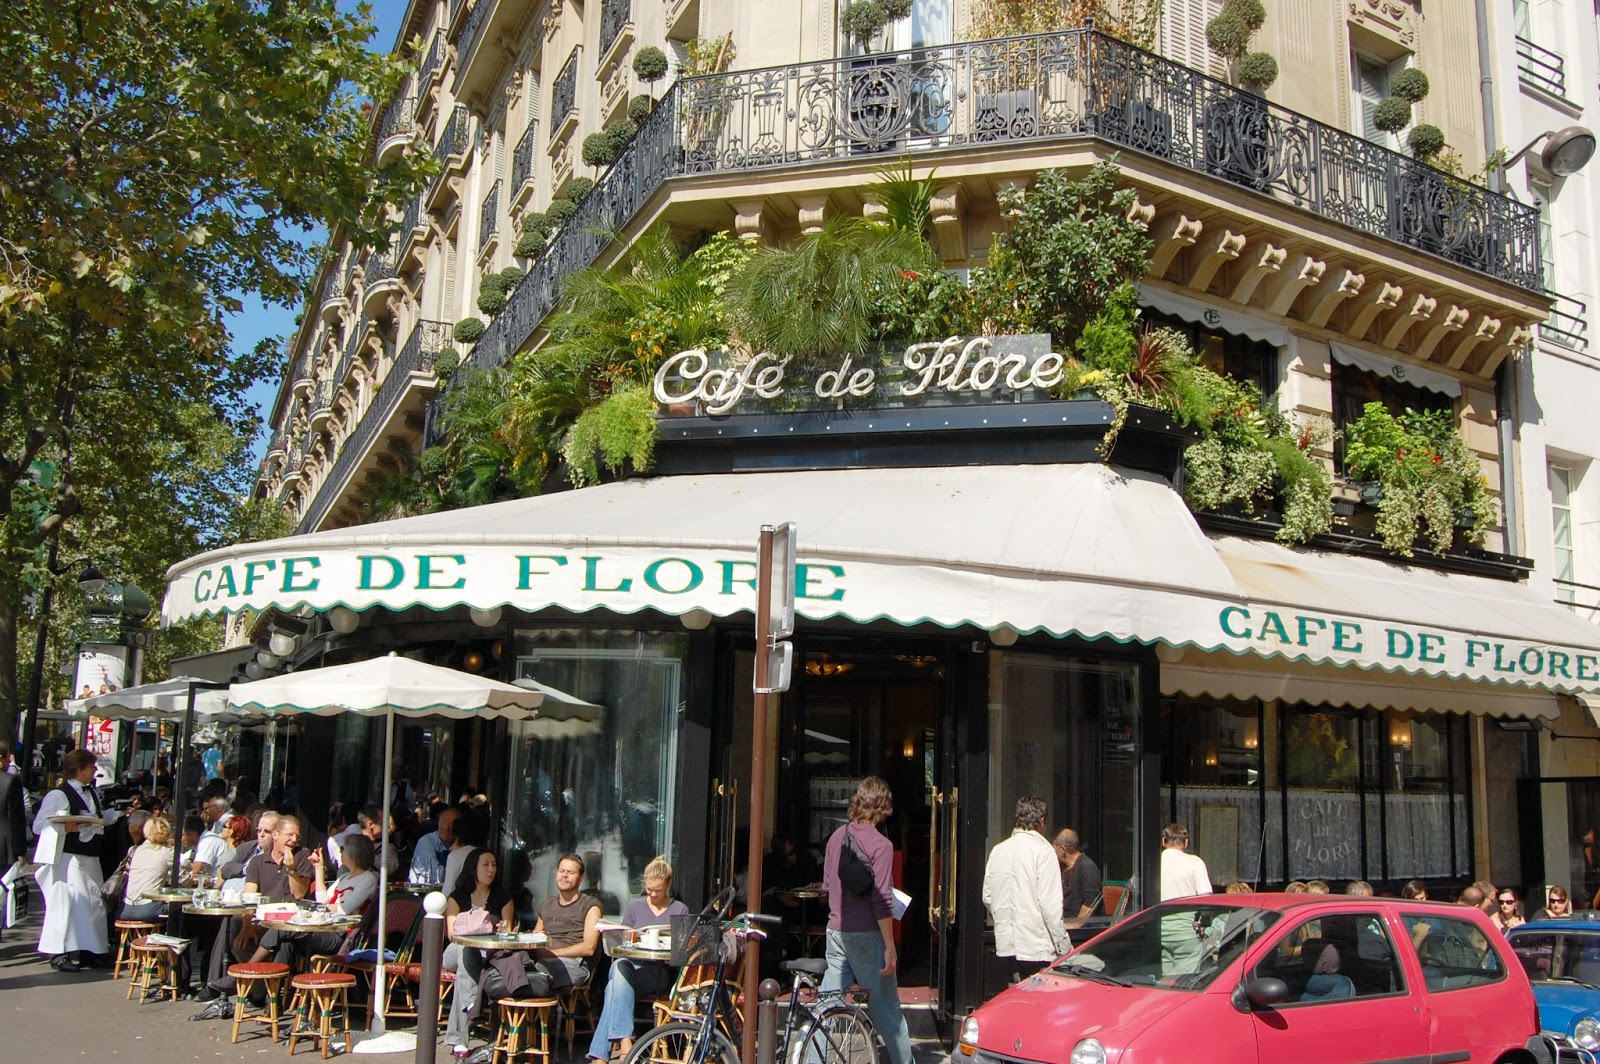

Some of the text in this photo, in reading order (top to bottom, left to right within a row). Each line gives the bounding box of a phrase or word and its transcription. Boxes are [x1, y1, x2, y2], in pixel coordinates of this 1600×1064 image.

[814, 352, 876, 398] de
[899, 335, 1066, 397] Flore
[194, 555, 847, 603] CAFE DE FLORE
[1219, 606, 1600, 682] CAFE DE FLORE
[1301, 800, 1348, 819] CAFE
[1317, 826, 1333, 837] DE
[1294, 838, 1355, 863] FLORE
